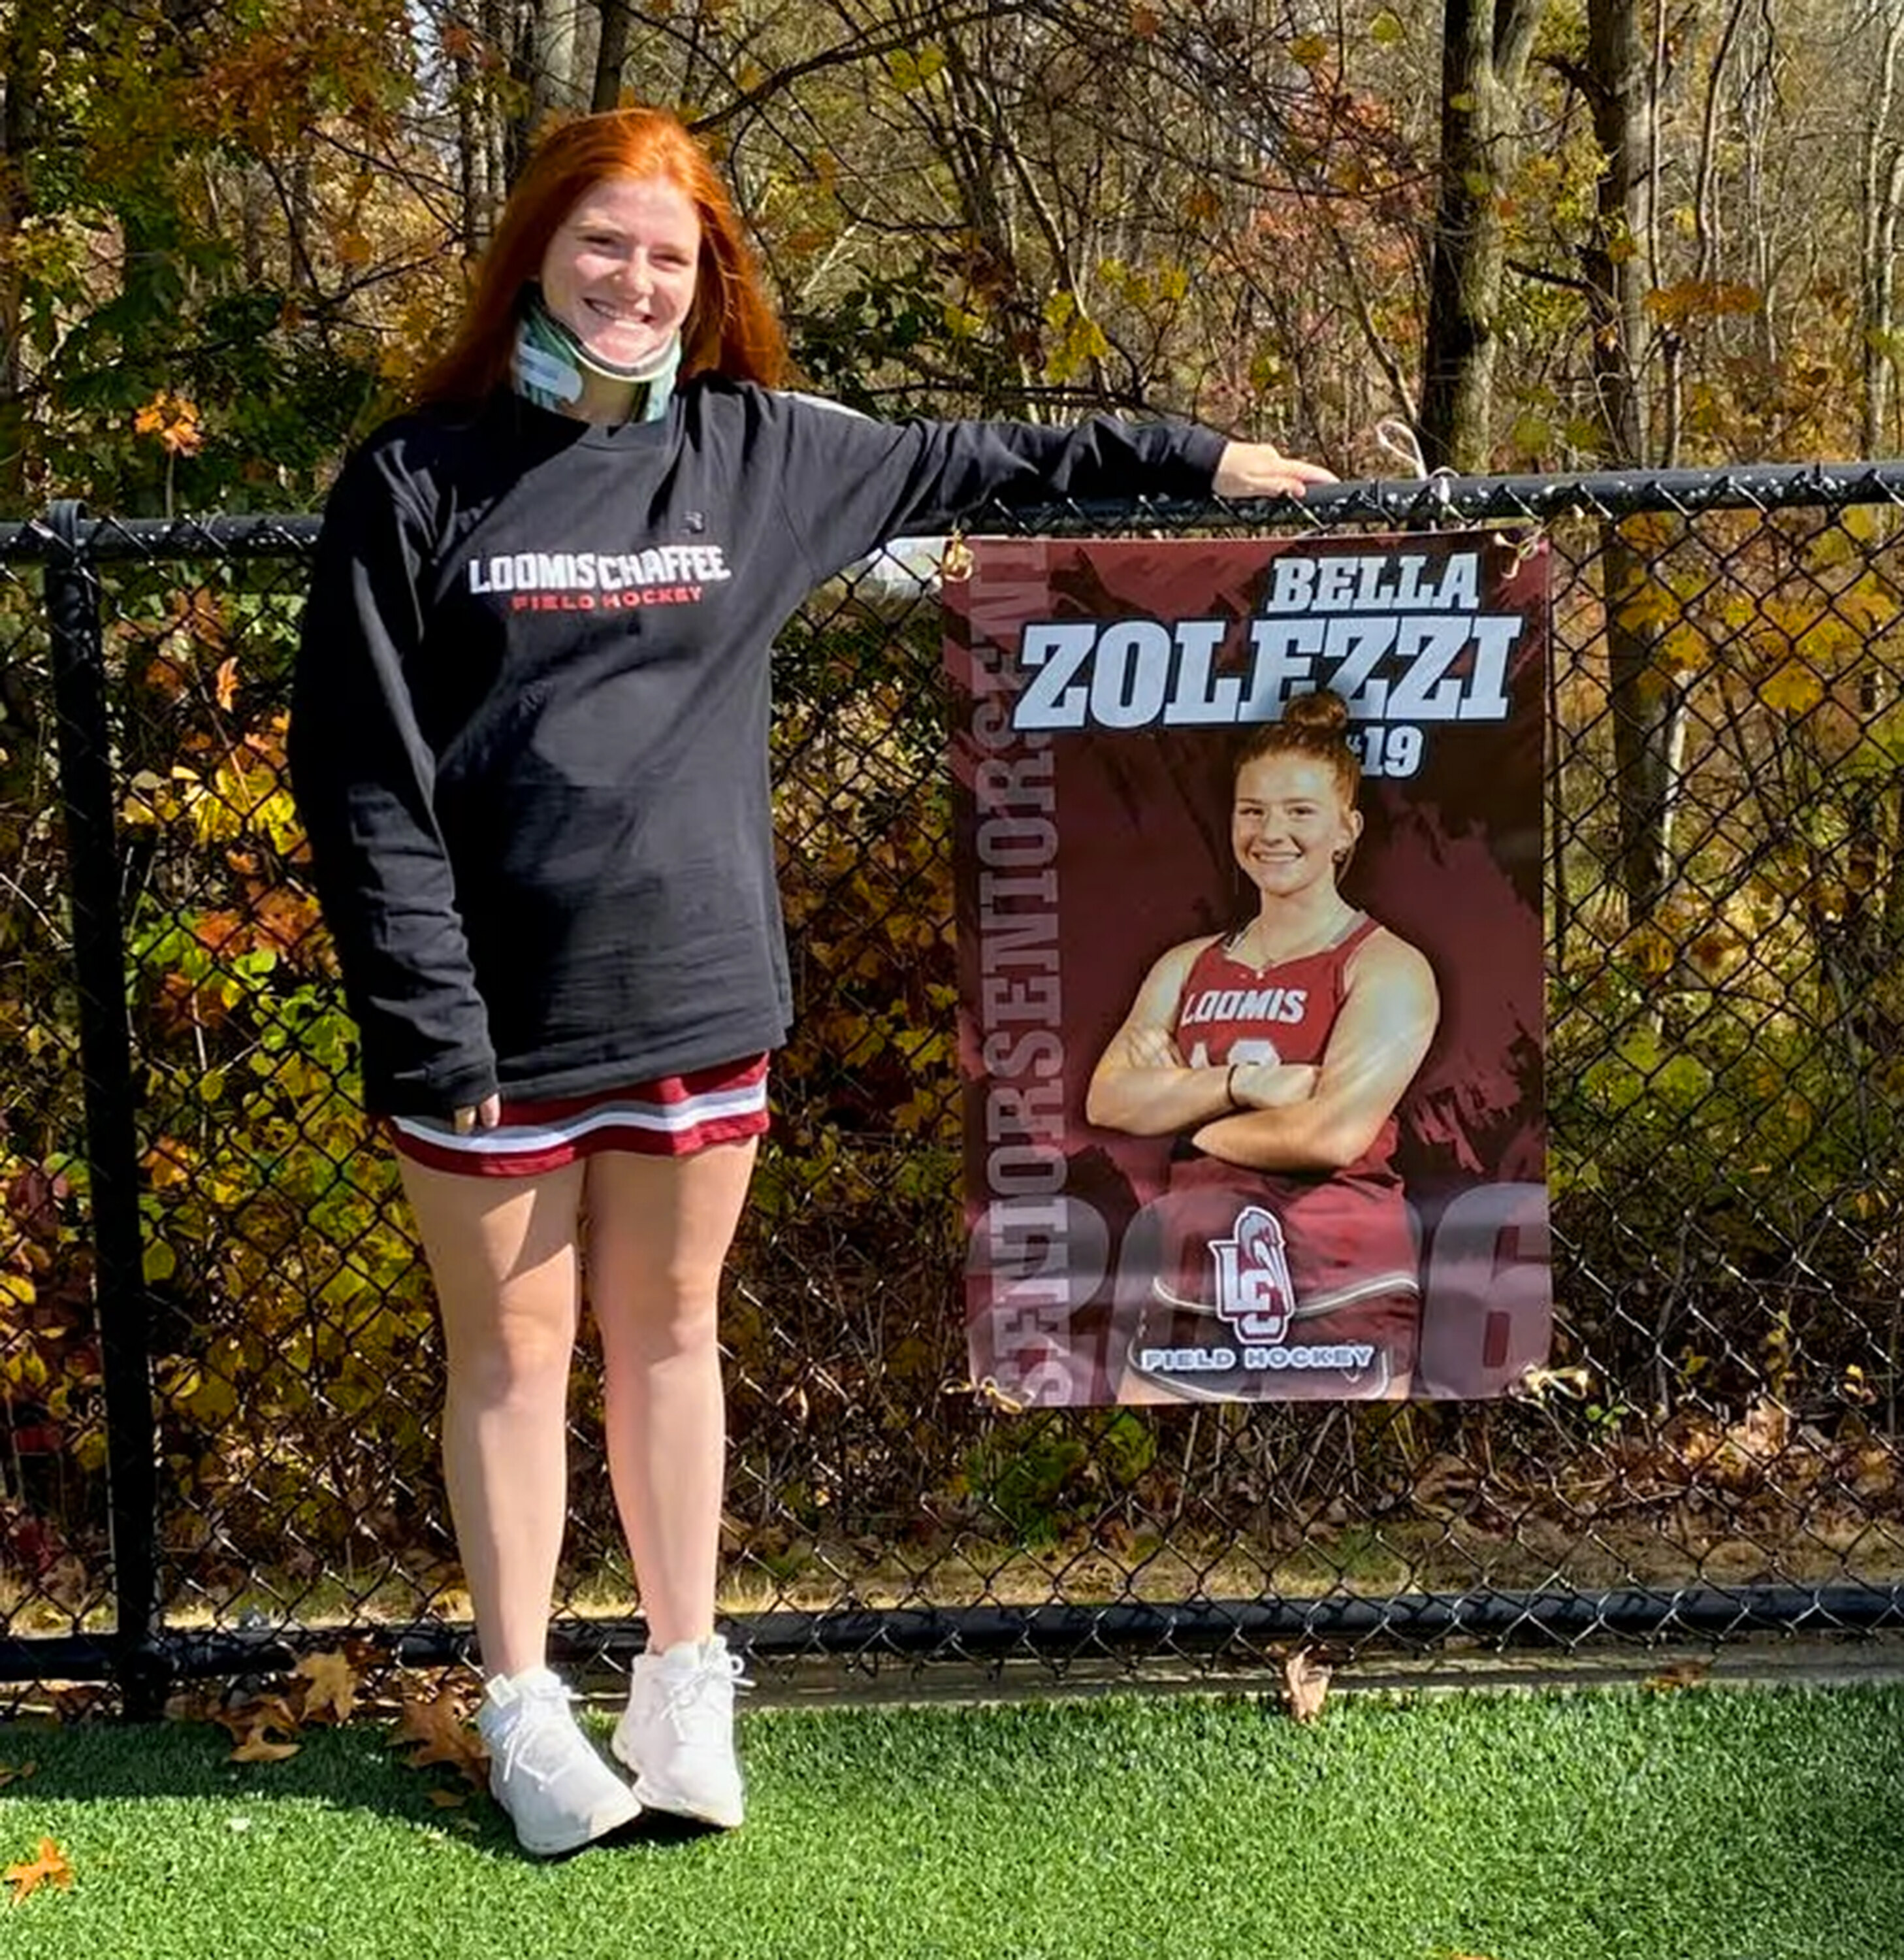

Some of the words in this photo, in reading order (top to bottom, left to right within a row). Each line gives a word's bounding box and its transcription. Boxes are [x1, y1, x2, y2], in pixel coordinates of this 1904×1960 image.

[511, 593, 595, 611] FIELD
[603, 587, 703, 608] HOCKEY
[1267, 553, 1479, 612] BELLA
[1013, 615, 1523, 729] ZOLEZZI
[1180, 988, 1307, 1026] LOOMIS
[1141, 1348, 1236, 1371] FIELD
[1243, 1346, 1374, 1369] HOCKEY
